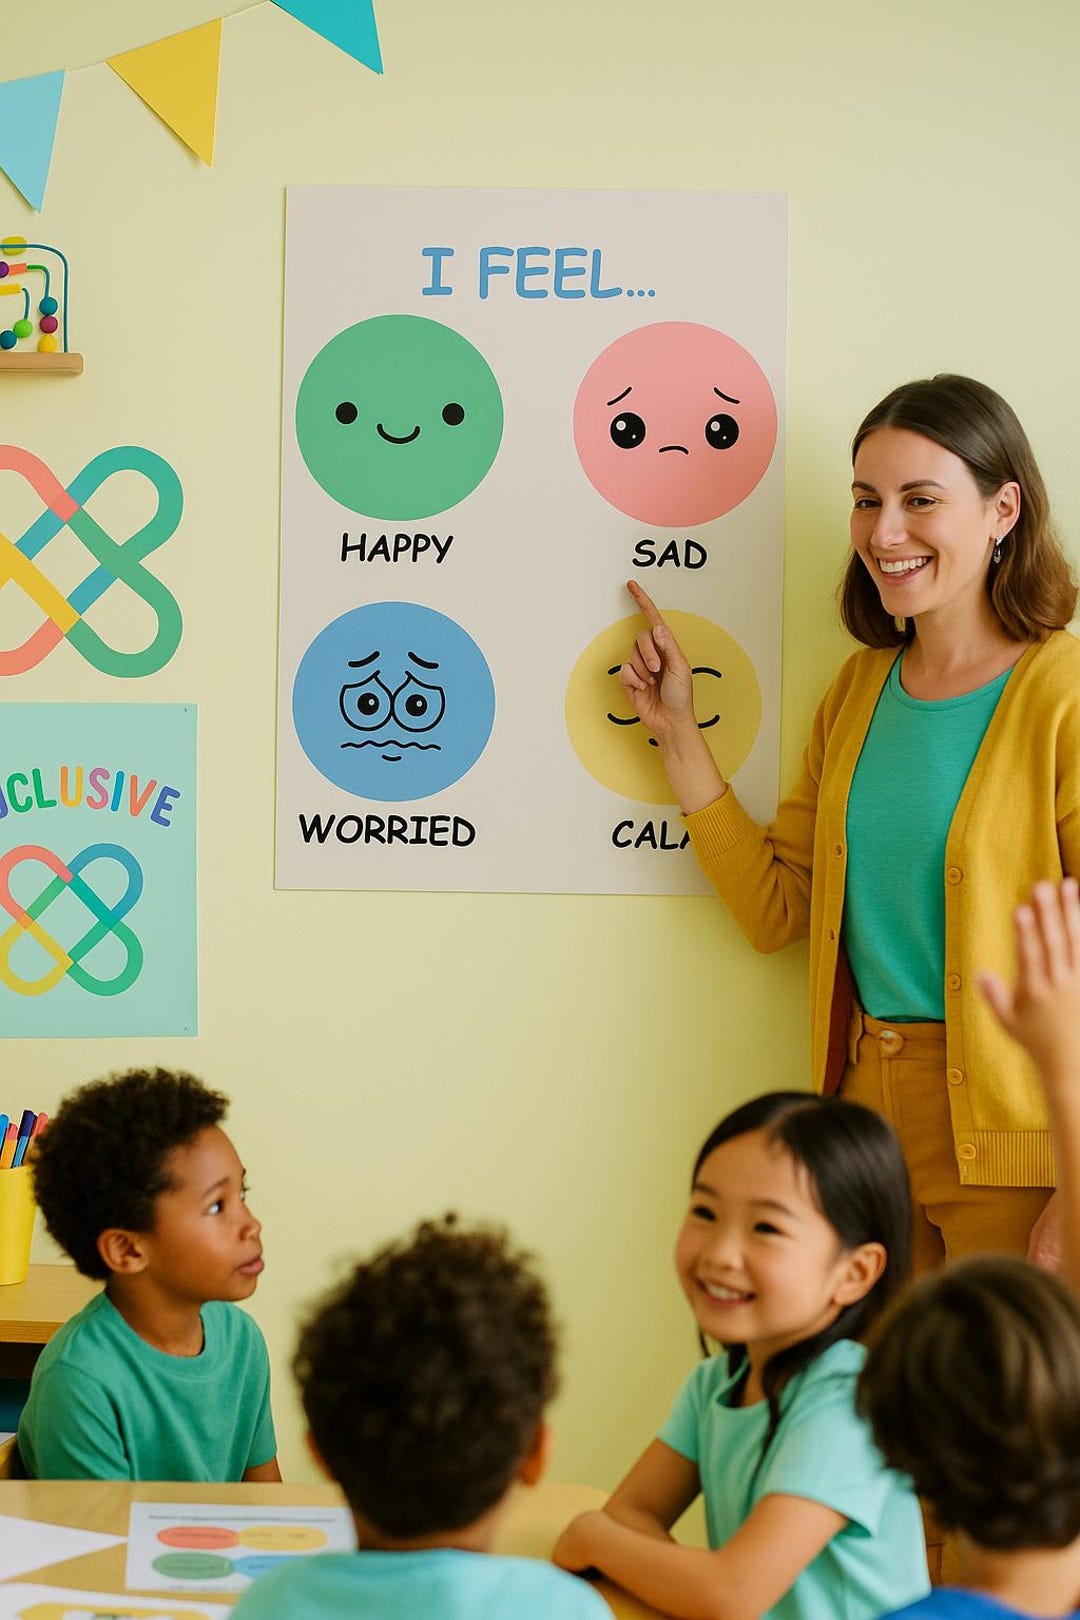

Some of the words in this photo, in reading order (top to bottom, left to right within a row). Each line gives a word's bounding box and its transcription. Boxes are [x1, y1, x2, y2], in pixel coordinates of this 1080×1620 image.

[421, 246, 455, 296] I
[479, 246, 656, 300] FEEL...
[341, 532, 454, 564] HAPPY
[631, 538, 708, 570] SAD
[298, 813, 476, 849] WORRIED
